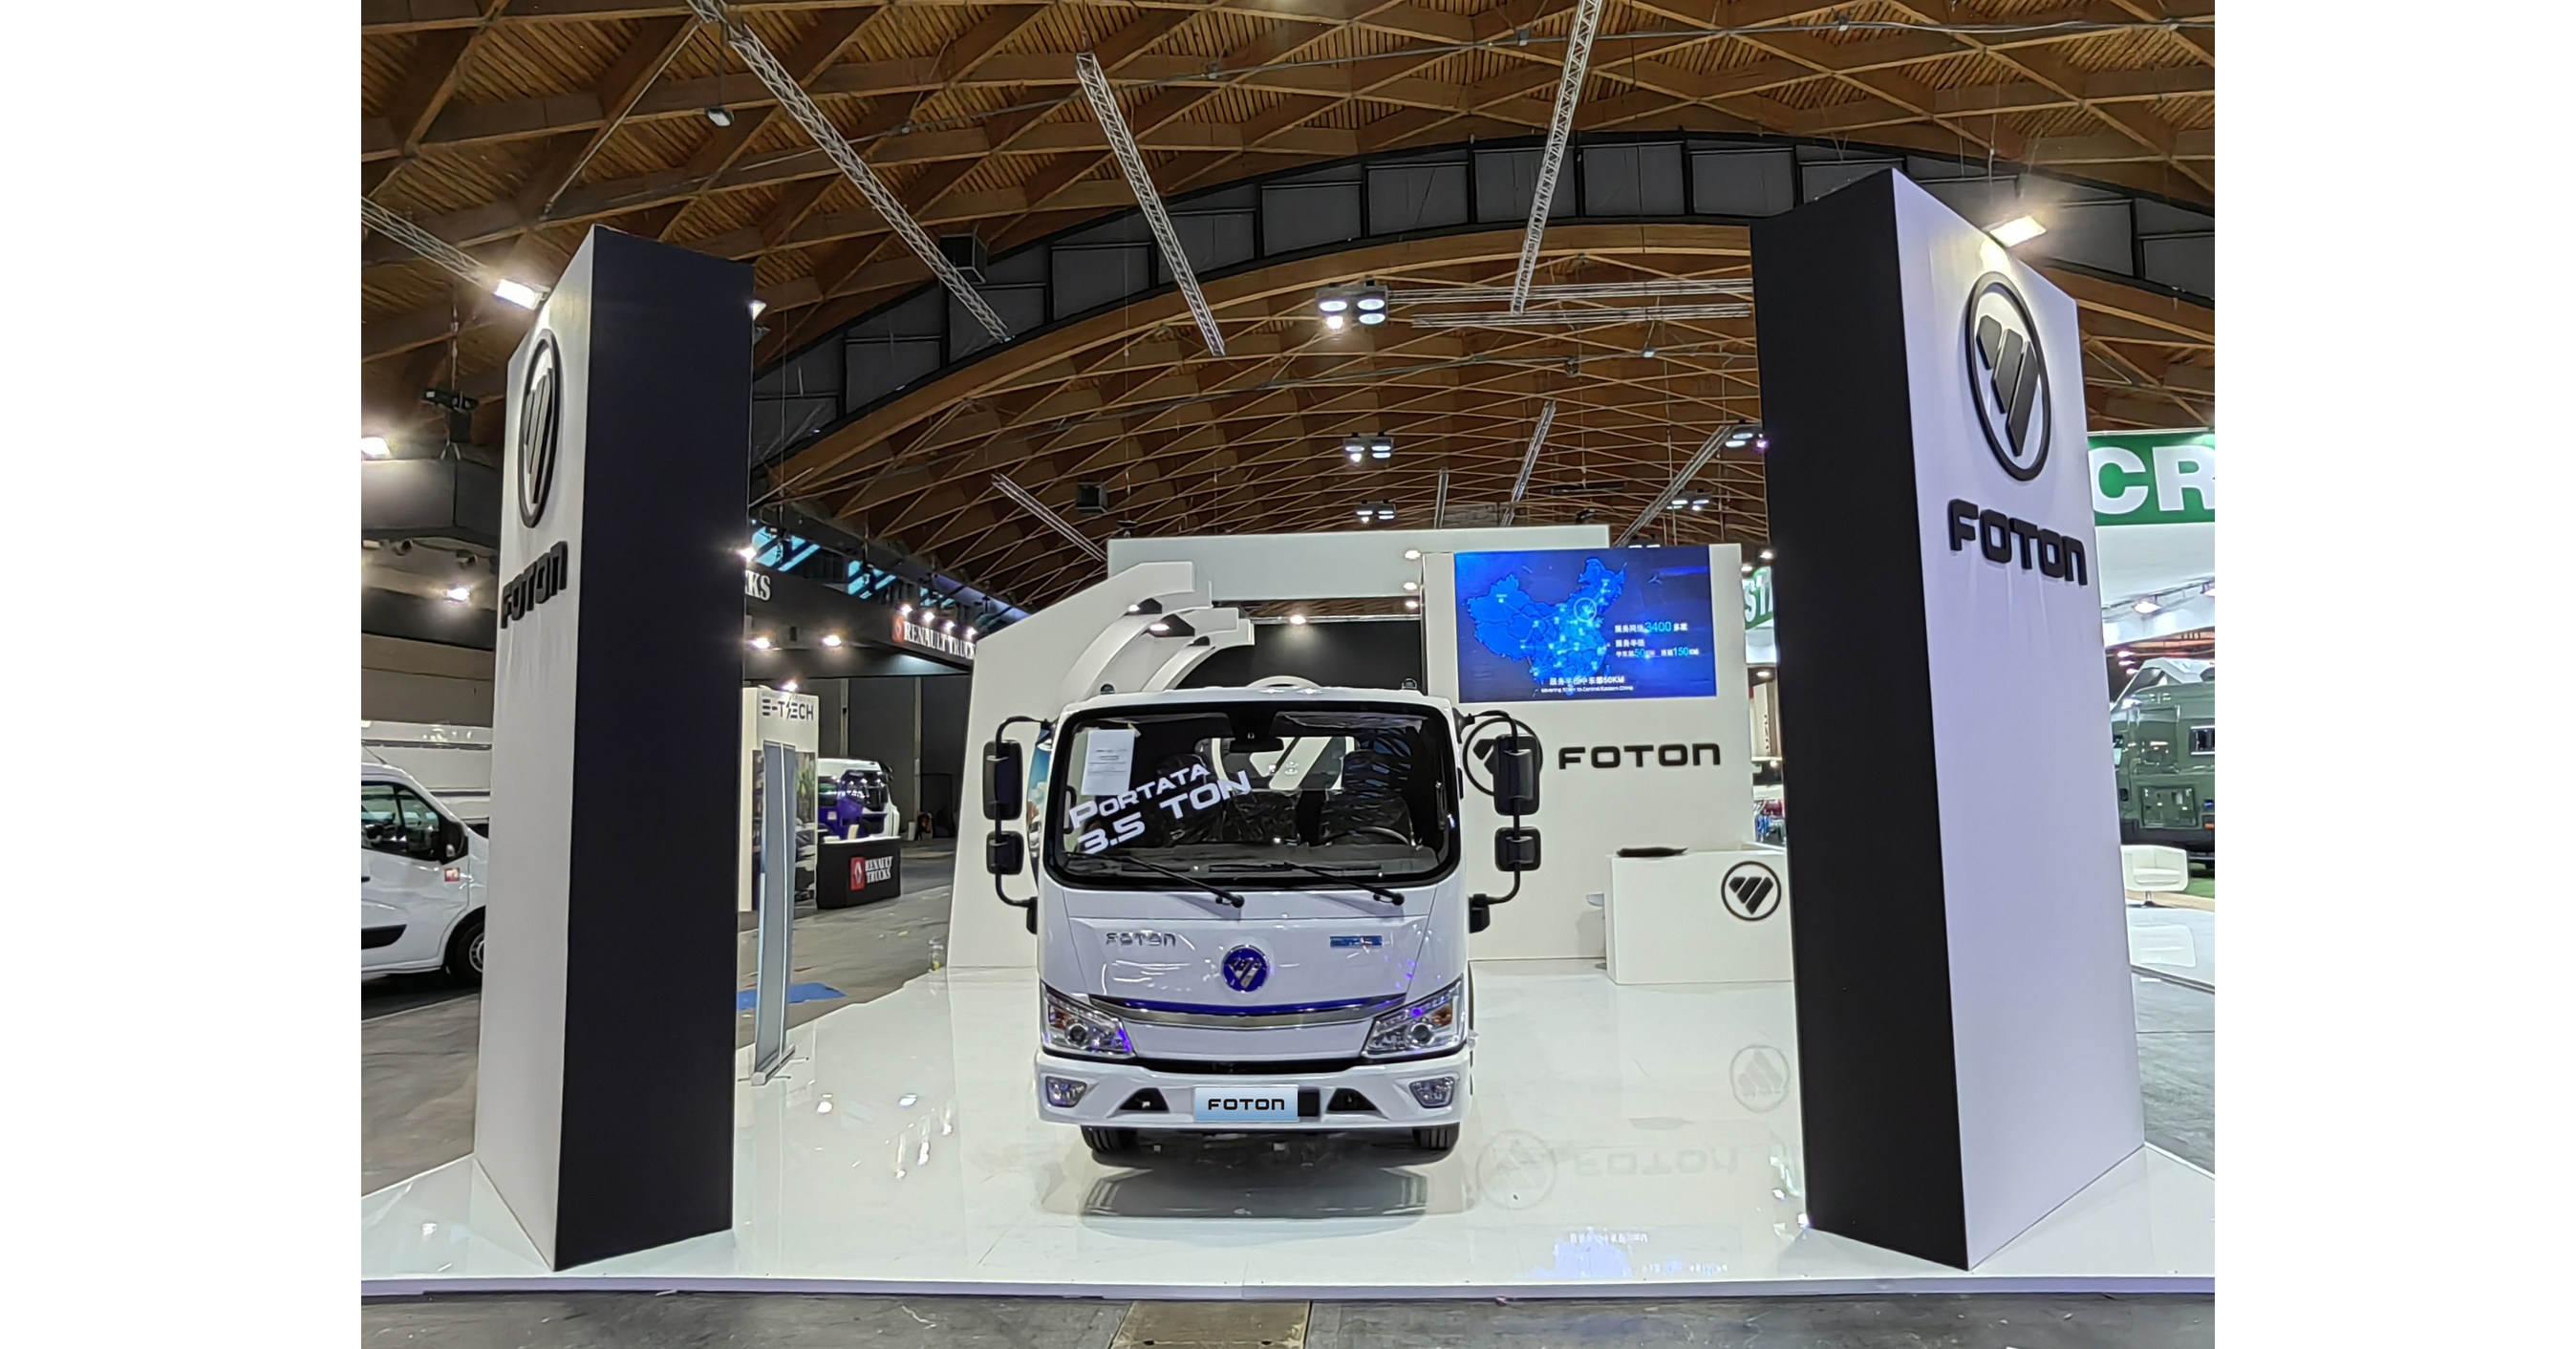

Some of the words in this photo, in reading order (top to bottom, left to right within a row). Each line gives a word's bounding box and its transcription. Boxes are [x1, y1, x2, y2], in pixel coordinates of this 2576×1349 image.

[1947, 499, 2088, 586] FOTON
[501, 541, 568, 629] FOTON
[745, 570, 771, 601] KS
[904, 620, 947, 653] RENAULT
[1558, 743, 1721, 769] FOTON
[1078, 812, 1146, 854] 3.5
[1159, 770, 1252, 820] TON
[1208, 1099, 1285, 1110] FOTON
